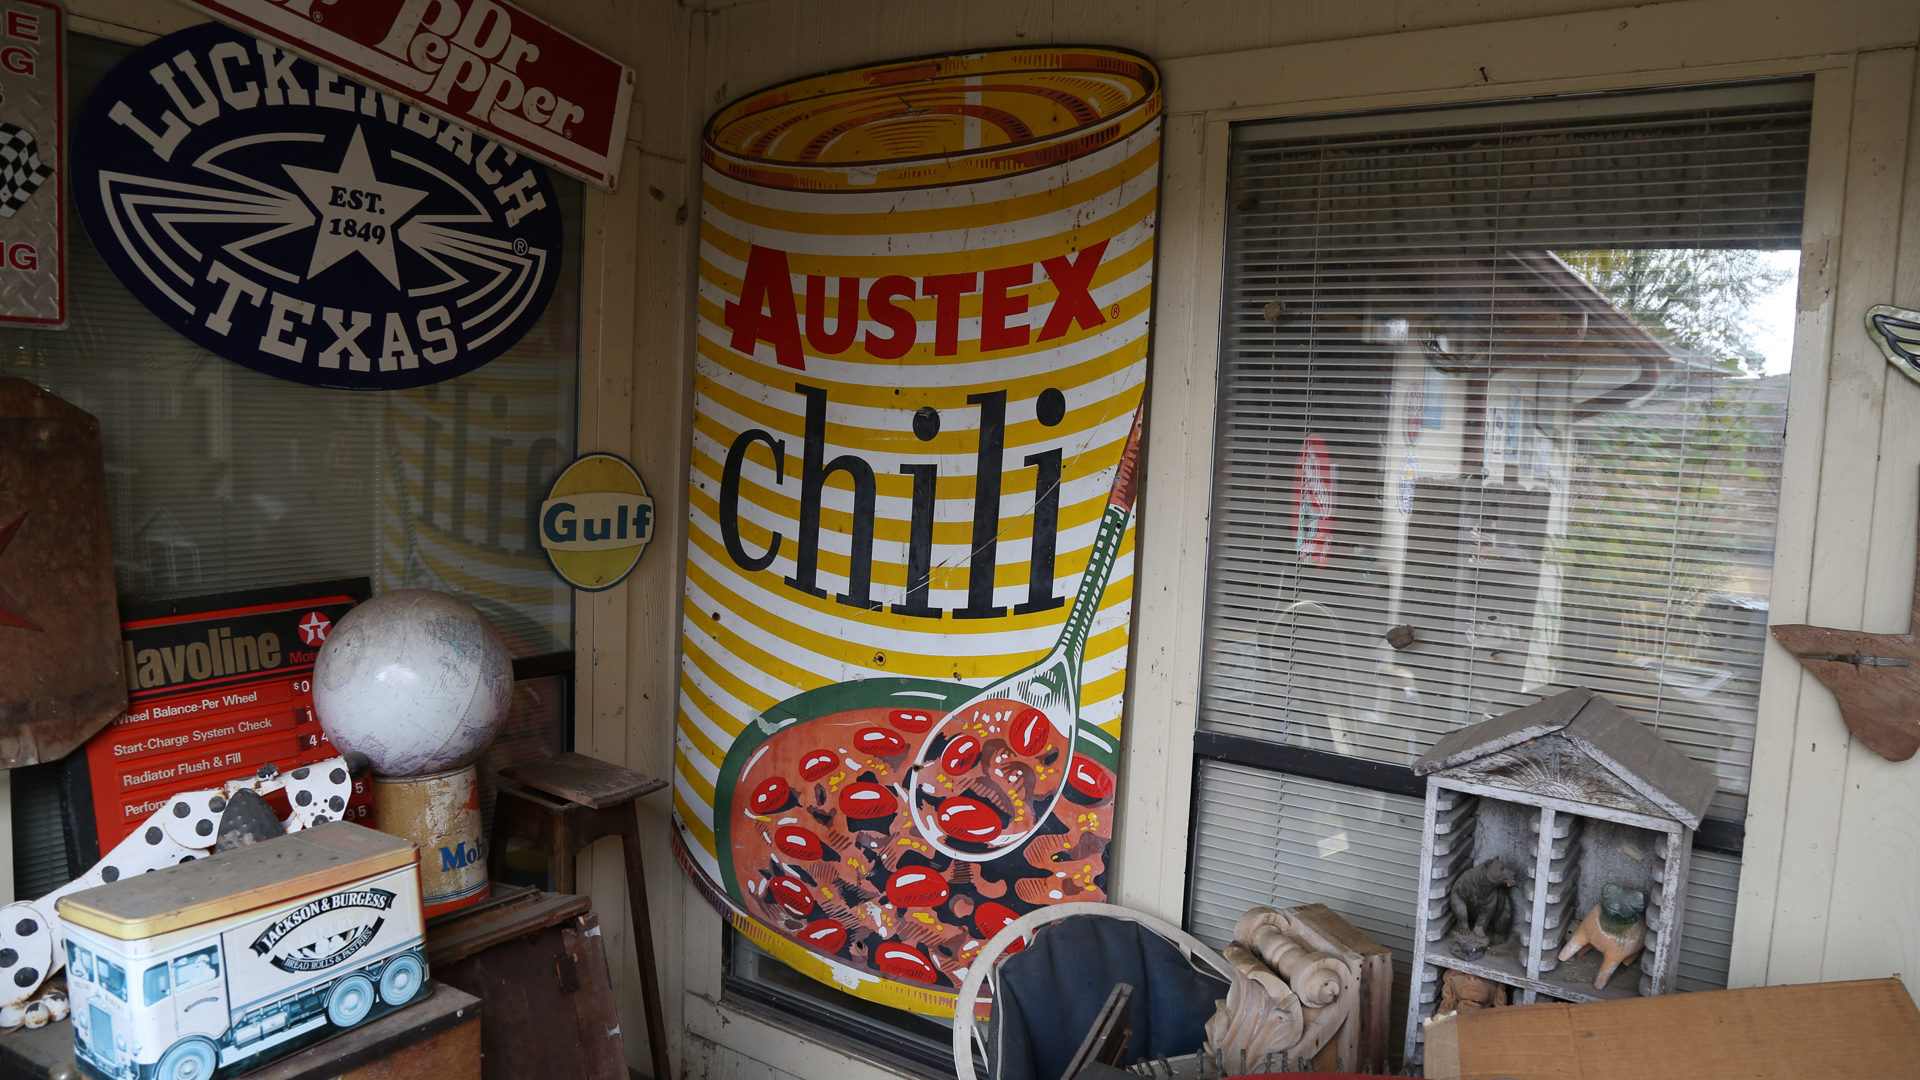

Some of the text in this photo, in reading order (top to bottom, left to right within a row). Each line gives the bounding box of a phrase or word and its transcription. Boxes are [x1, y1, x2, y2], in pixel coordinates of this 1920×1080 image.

[373, 0, 585, 136] Pepper
[328, 185, 386, 215] EST.
[328, 218, 387, 245] 1849
[204, 259, 459, 373] TEXAS
[718, 382, 1067, 620] chili
[542, 502, 653, 544] Gulf
[152, 699, 220, 719] Balance-Per
[222, 691, 258, 707] Wheel
[113, 717, 273, 757] Start-Charge System Check
[122, 752, 242, 787] Radiator Flush & Fill
[261, 899, 321, 949] JACKSON
[320, 897, 331, 912] &
[331, 891, 387, 910] BURGESS
[311, 956, 335, 970] ROLLS
[342, 928, 373, 959] PASTRIES
